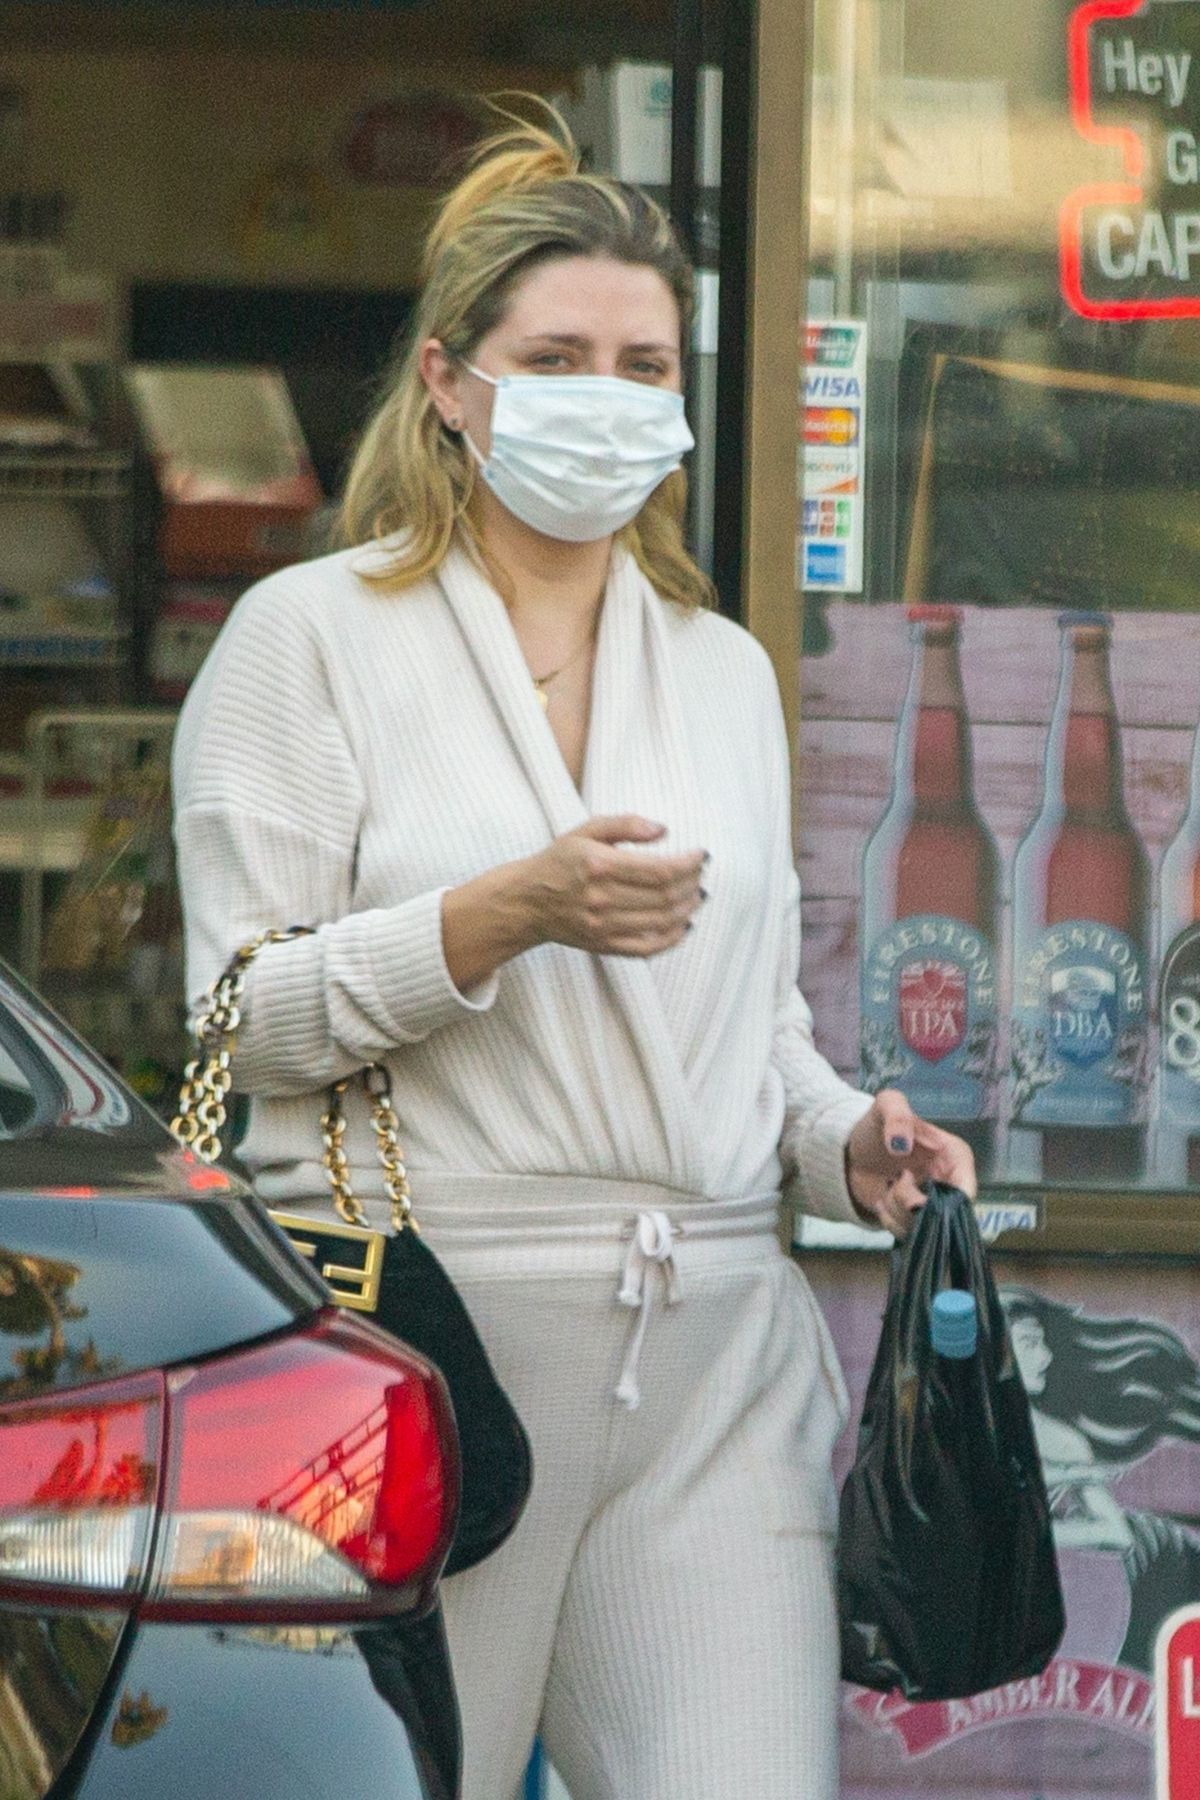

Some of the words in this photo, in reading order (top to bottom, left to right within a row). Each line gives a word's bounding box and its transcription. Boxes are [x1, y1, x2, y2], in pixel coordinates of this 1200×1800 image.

[1102, 38, 1191, 107] Hey
[800, 376, 861, 398] VISA
[909, 1010, 959, 1038] IPA
[1054, 1010, 1112, 1040] DBA
